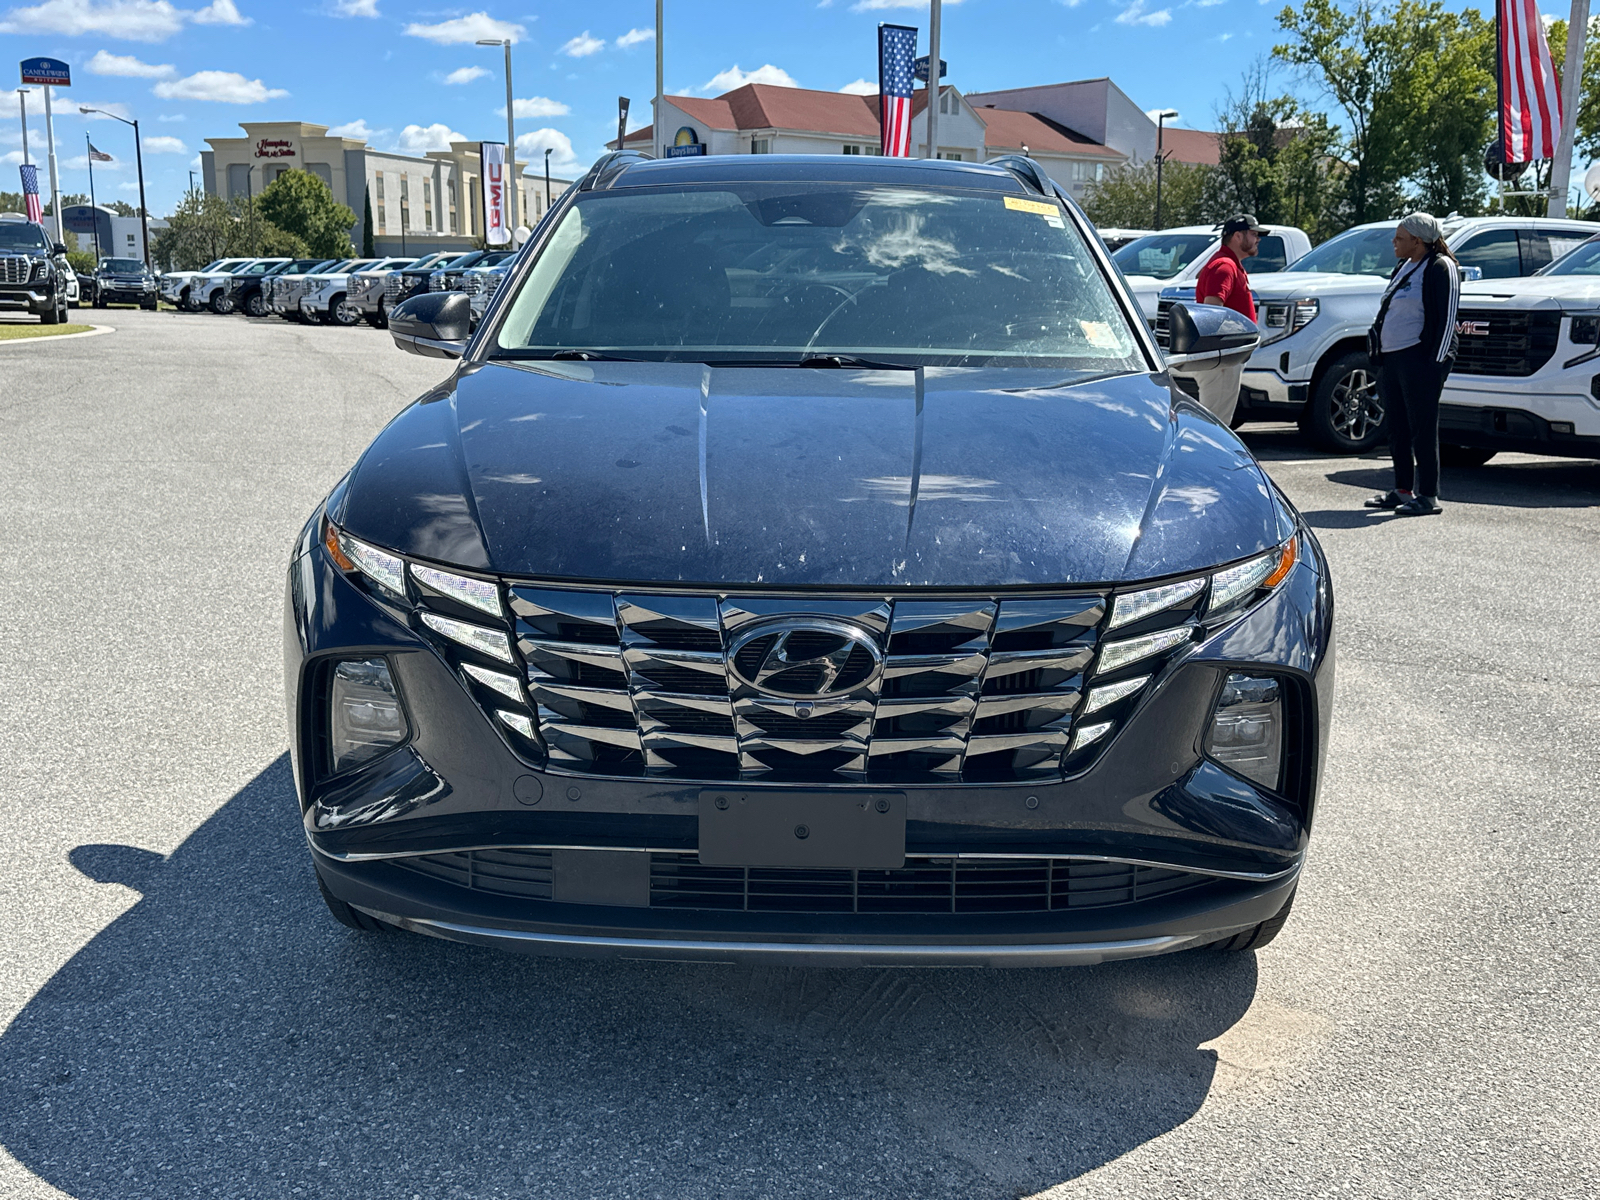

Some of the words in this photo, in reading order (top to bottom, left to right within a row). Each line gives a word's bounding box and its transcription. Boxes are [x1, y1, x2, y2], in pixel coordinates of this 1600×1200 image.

[256, 138, 293, 149] Hampton
[670, 148, 686, 157] Days
[687, 146, 698, 154] Inn
[489, 163, 502, 228] GMC
[1454, 320, 1490, 335] MC
